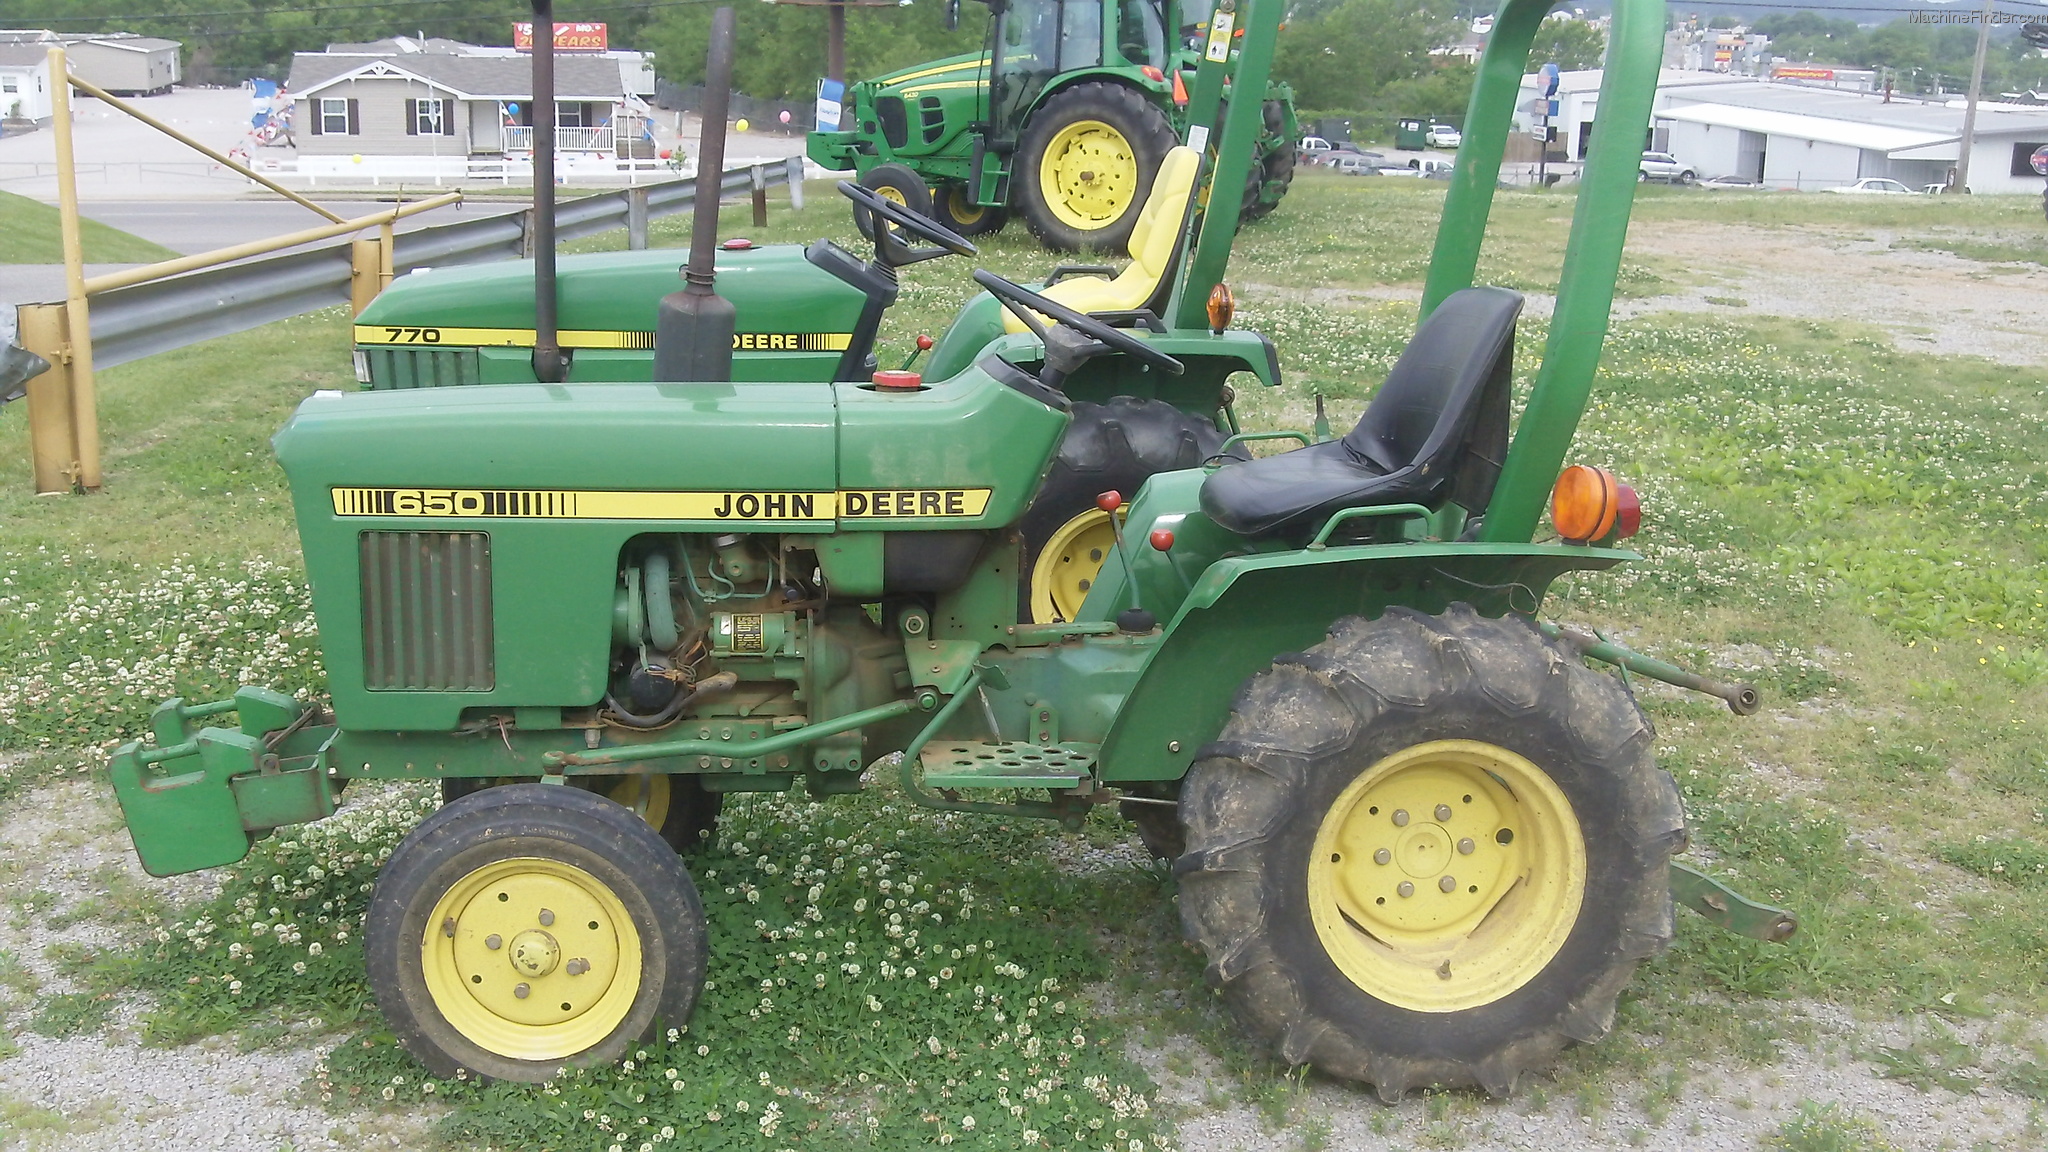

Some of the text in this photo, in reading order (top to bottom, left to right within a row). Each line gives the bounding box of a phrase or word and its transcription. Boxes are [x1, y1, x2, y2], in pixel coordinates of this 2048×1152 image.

[385, 328, 441, 343] 770
[392, 490, 486, 516] 650
[714, 491, 965, 518] JOHN DEERE
